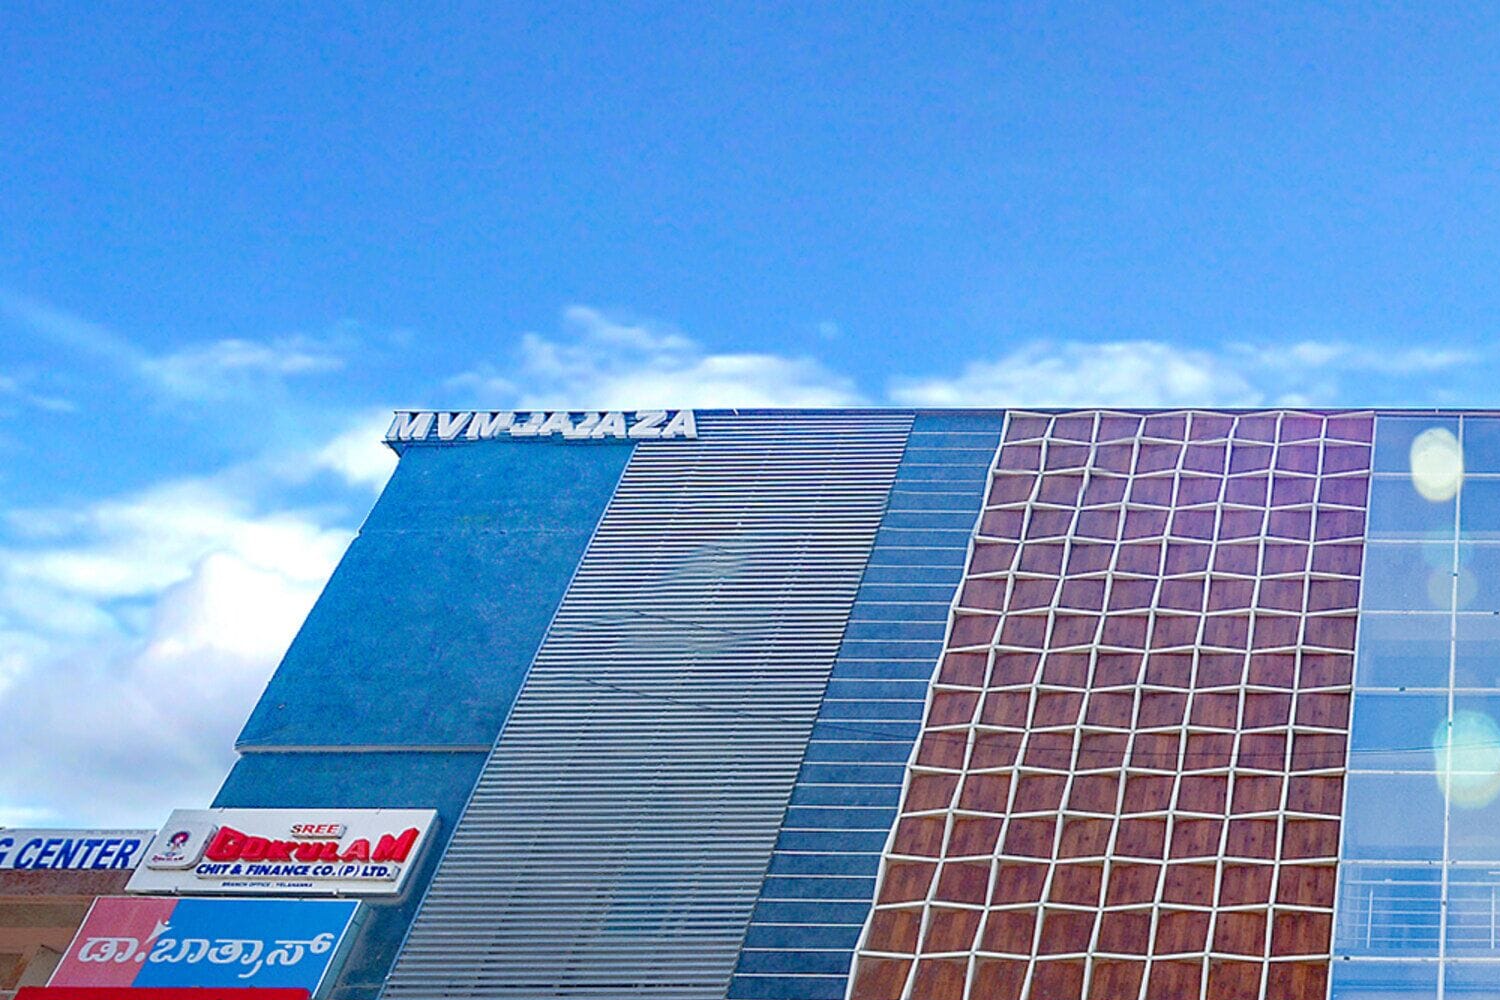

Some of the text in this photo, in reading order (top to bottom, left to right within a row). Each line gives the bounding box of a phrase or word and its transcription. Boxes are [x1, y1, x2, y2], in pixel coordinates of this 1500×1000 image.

[291, 824, 340, 834] SREE
[14, 838, 141, 869] CENTER
[196, 864, 230, 875] CHIT
[230, 864, 243, 875] &
[246, 865, 310, 876] FINANCE
[362, 865, 392, 877] LTD.
